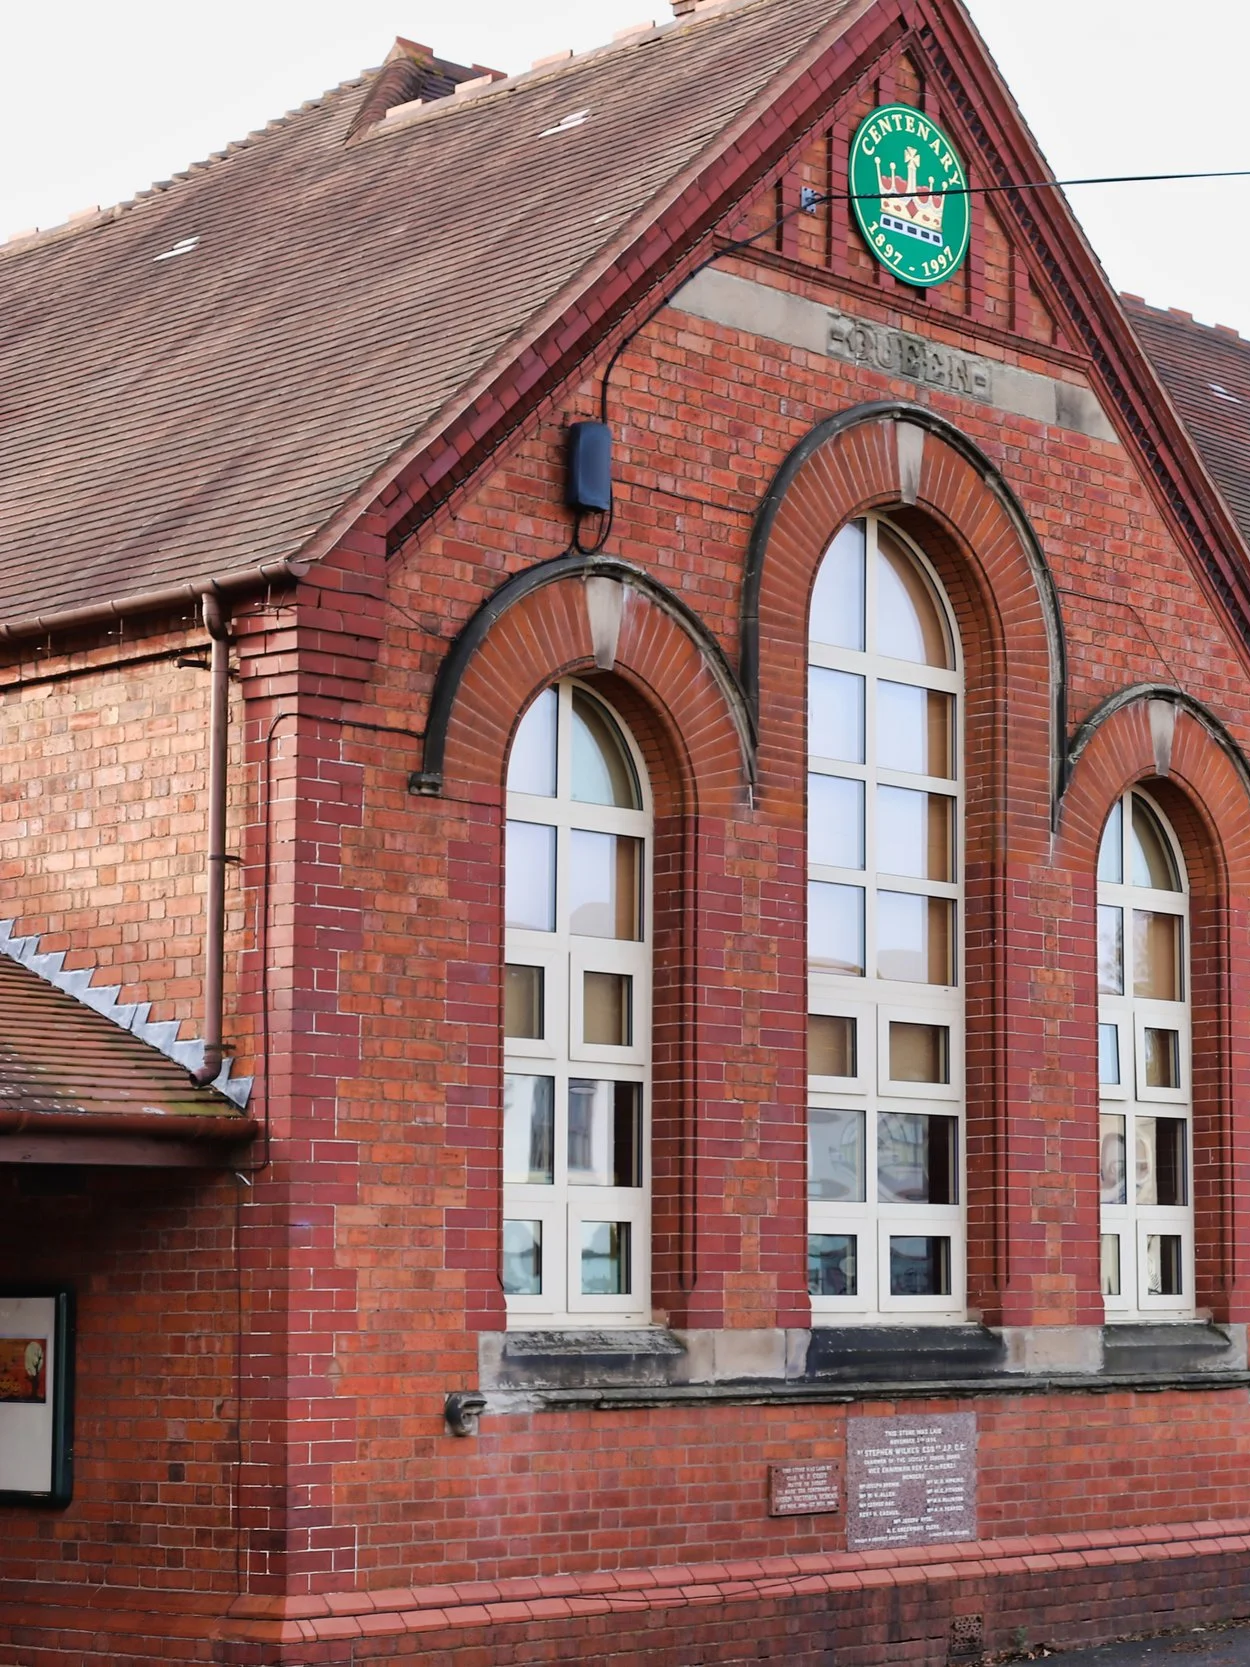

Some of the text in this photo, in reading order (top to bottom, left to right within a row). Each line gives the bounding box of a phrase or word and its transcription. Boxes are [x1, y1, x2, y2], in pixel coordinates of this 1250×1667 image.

[862, 114, 961, 186] CENTENARY
[867, 221, 904, 267] 1897
[921, 246, 954, 277] 1997
[845, 323, 973, 394] QUEEN
